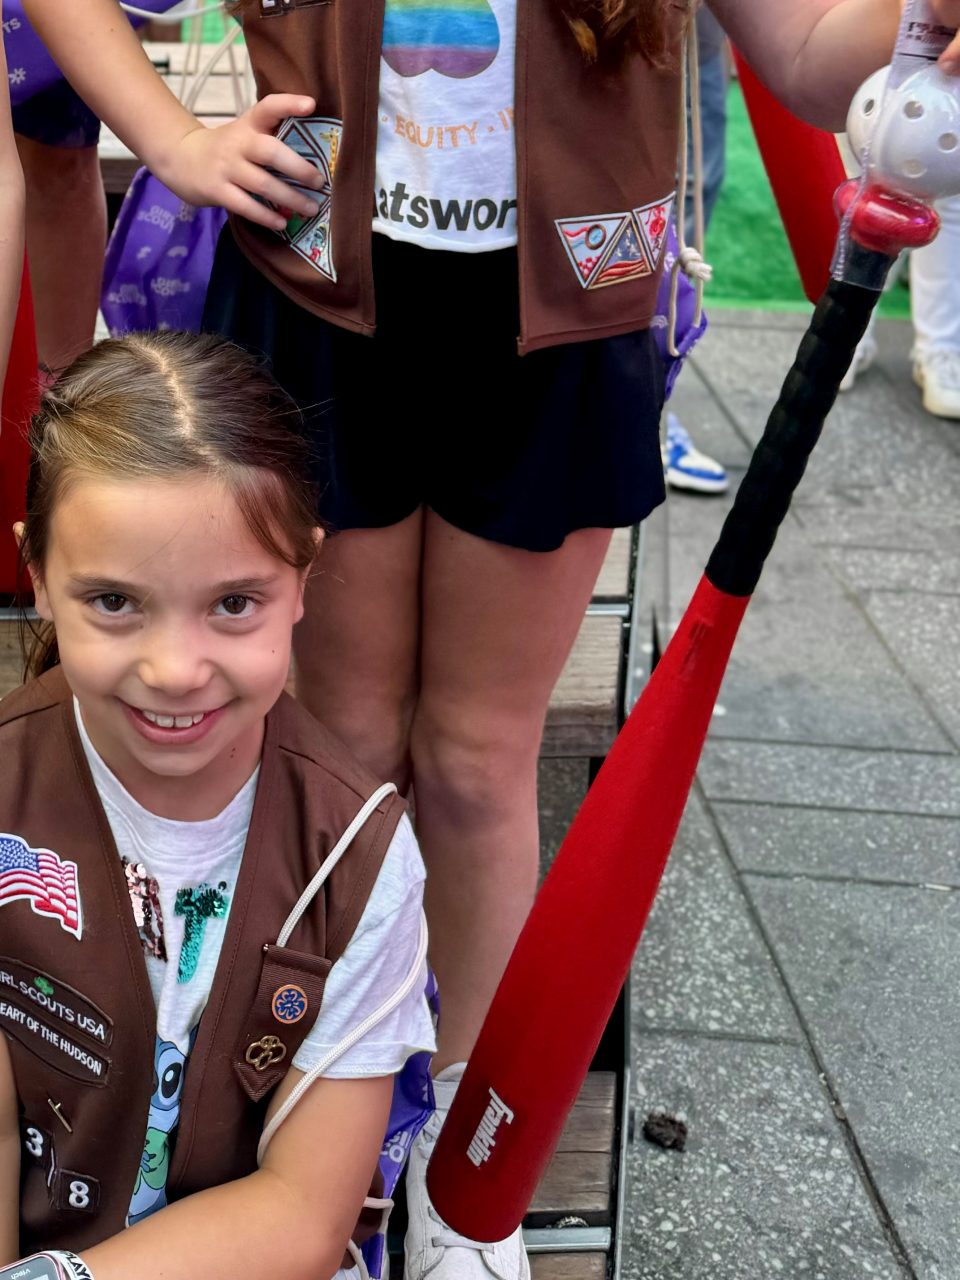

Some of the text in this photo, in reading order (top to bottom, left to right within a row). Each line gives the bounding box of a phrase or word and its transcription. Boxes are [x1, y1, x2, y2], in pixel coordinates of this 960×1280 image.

[394, 114, 479, 149] EQUITY
[19, 981, 75, 1023] SCOUTS
[76, 1013, 106, 1041] USA
[26, 1017, 41, 1034] OF
[40, 1025, 59, 1048] THE
[59, 1038, 102, 1076] HUDSON
